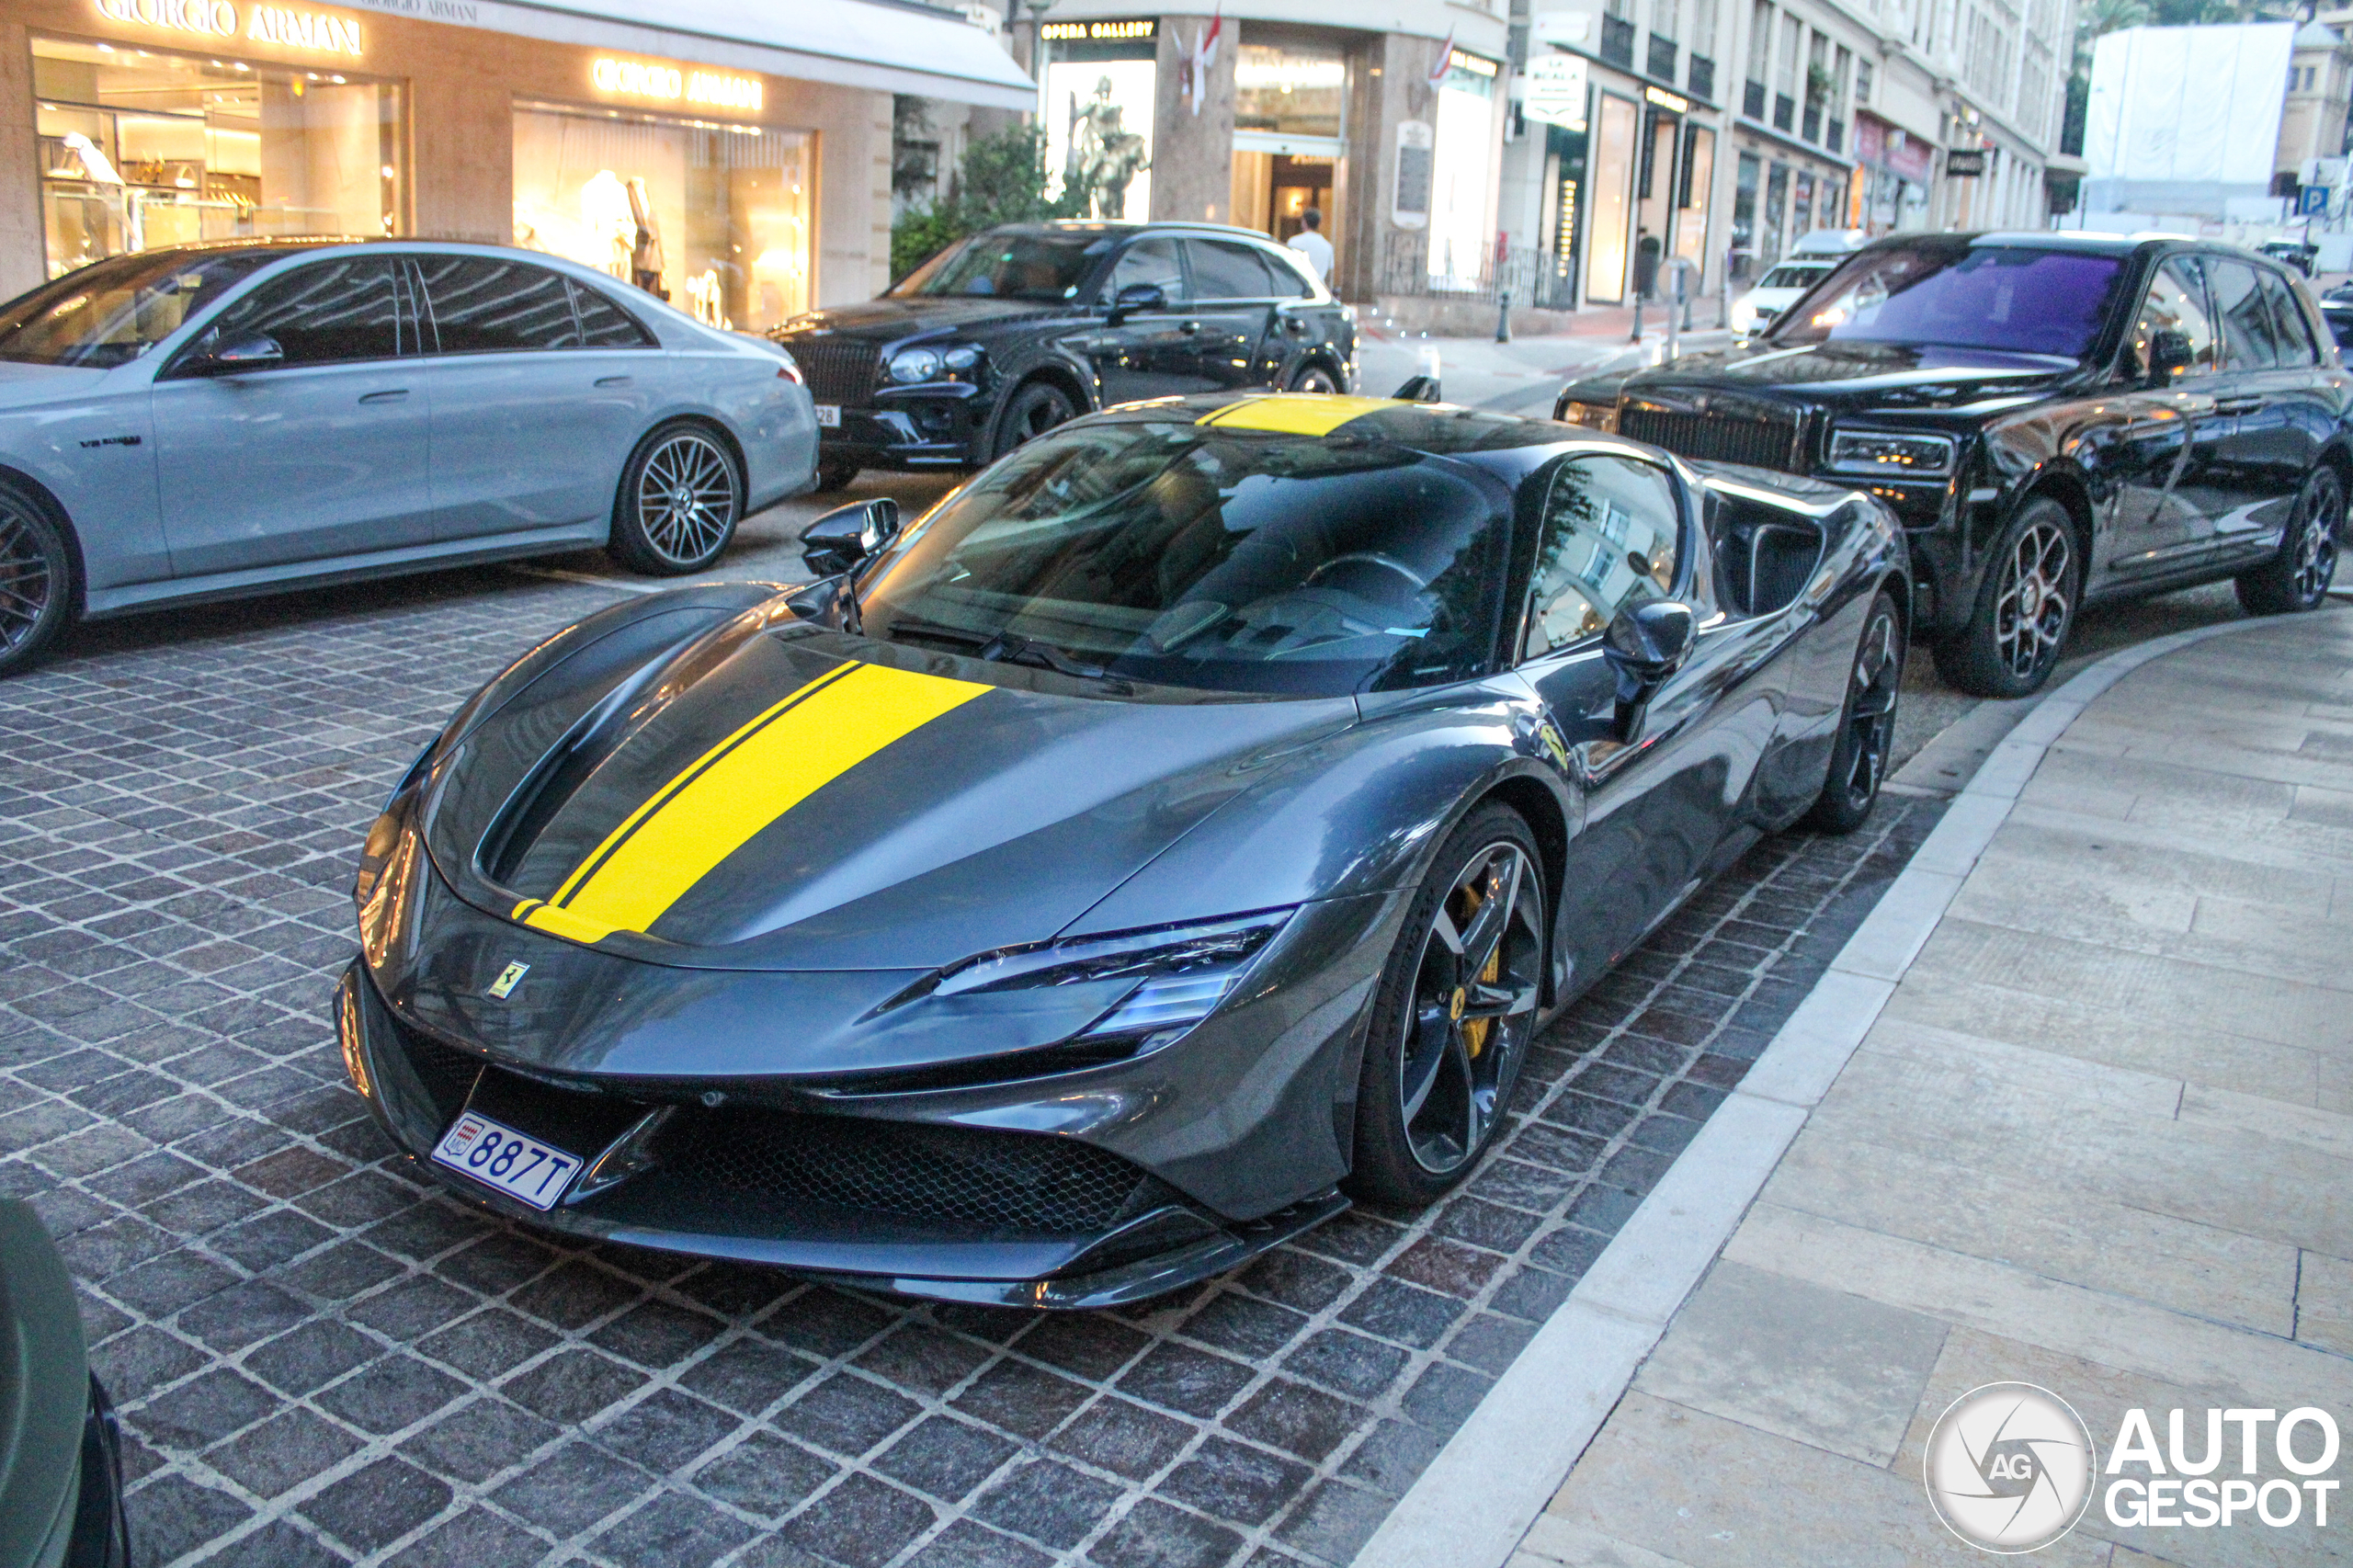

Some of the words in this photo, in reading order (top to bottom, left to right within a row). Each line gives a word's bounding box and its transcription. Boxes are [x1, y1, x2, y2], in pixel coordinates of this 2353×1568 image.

[426, 0, 478, 23] ARMANI
[95, 0, 237, 38] GIORGIO
[246, 4, 363, 56] ARMANI
[1040, 23, 1088, 40] OPERA
[1090, 20, 1154, 39] GALLERY
[2308, 190, 2323, 212] P
[449, 1138, 467, 1153] MC
[468, 1131, 571, 1197] 887T
